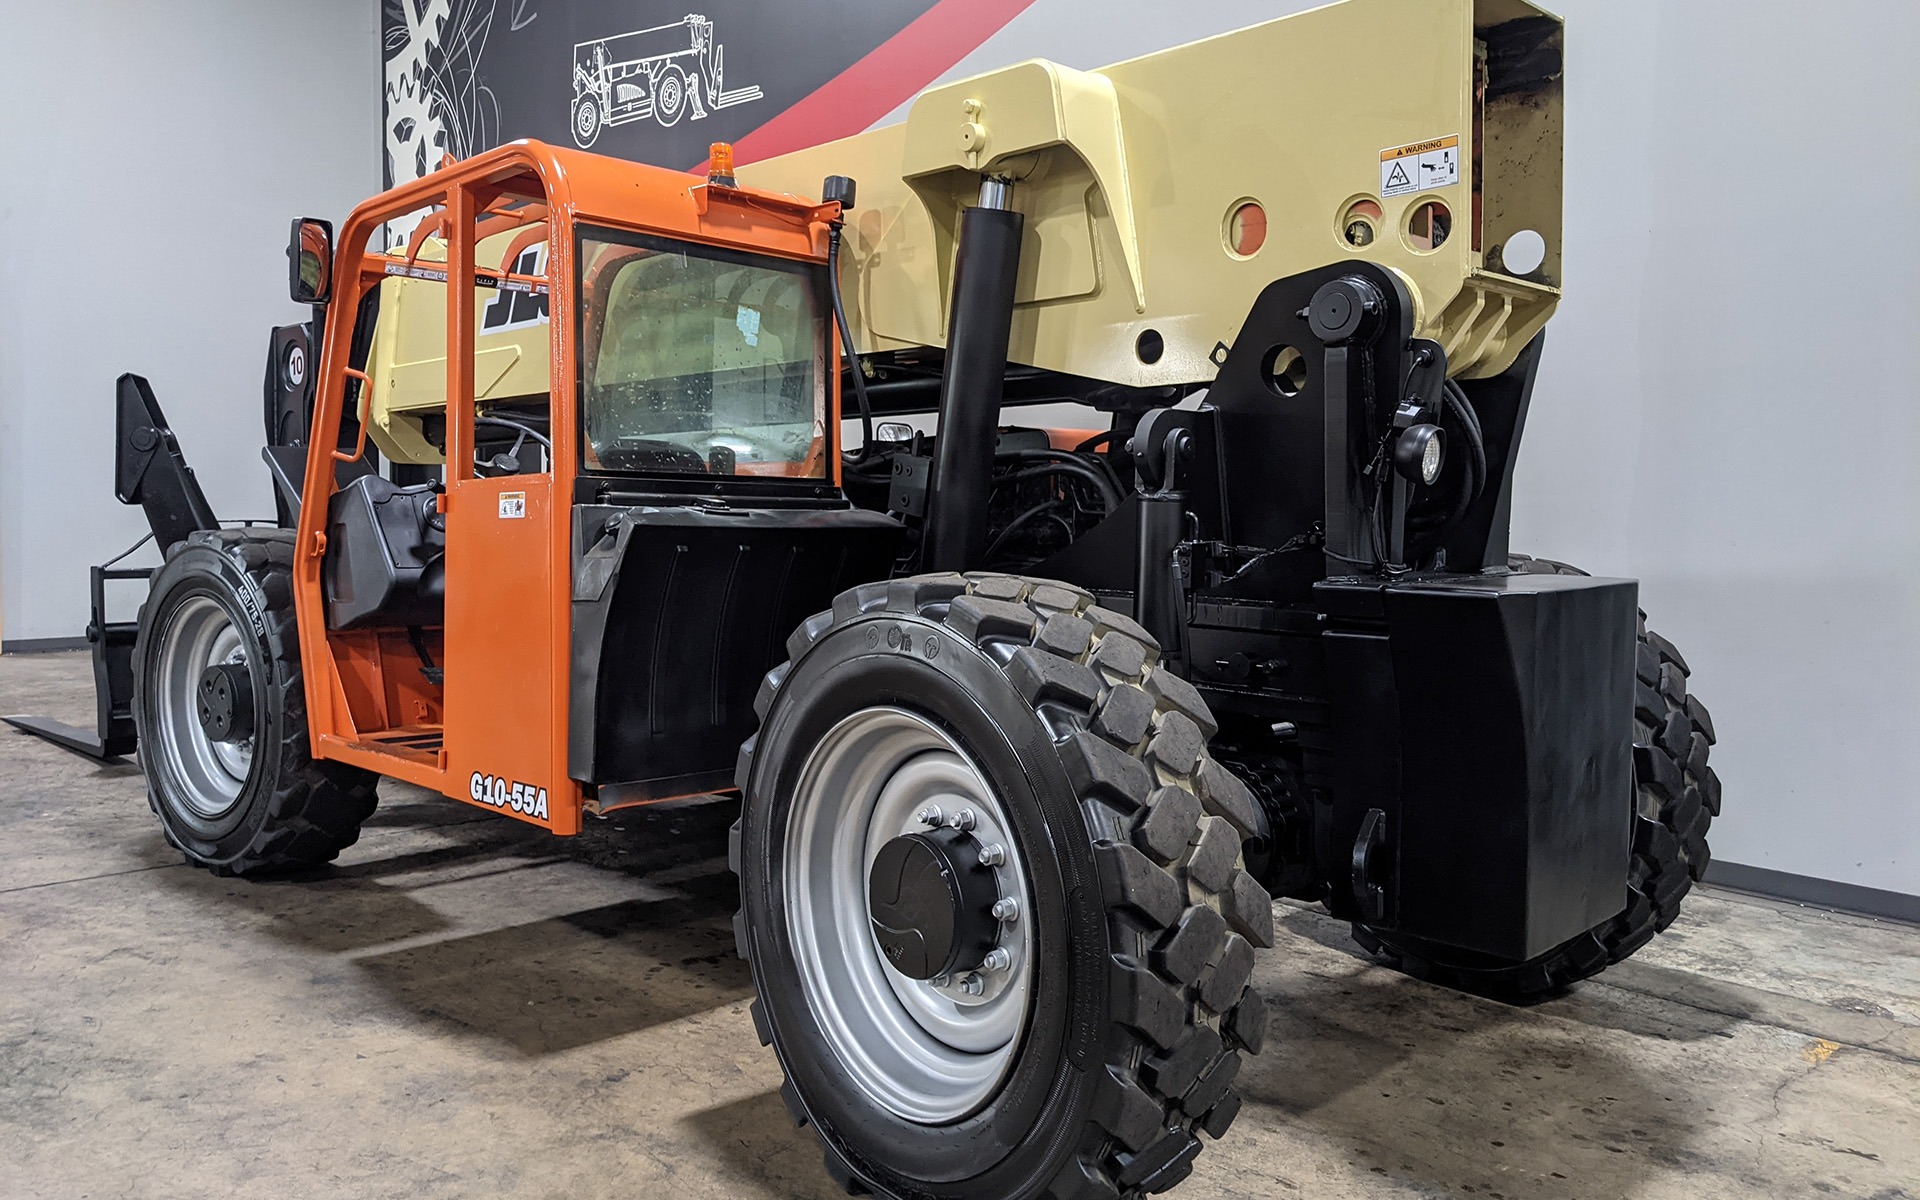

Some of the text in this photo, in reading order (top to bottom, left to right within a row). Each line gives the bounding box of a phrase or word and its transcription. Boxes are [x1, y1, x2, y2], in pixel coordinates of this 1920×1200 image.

[1405, 140, 1442, 154] WARNING
[291, 355, 303, 375] 10
[237, 585, 265, 637] 400/75-28
[470, 770, 549, 821] G10-55A
